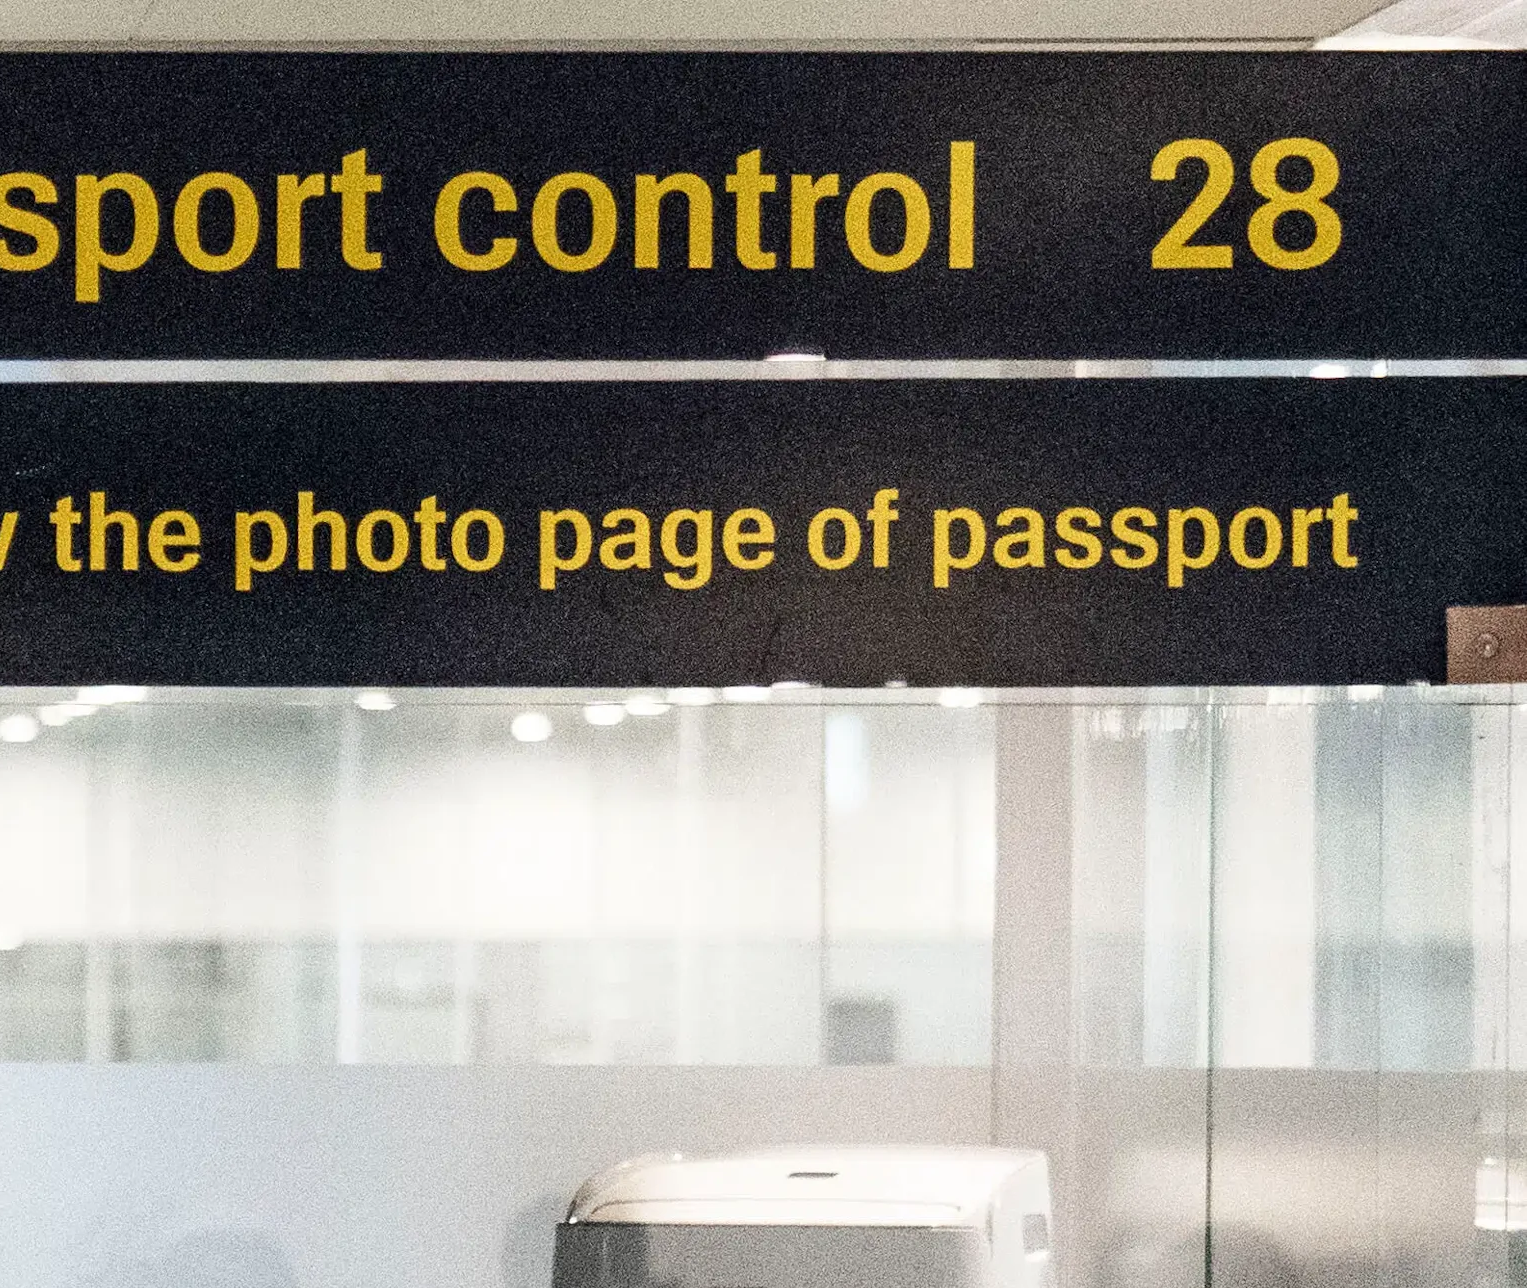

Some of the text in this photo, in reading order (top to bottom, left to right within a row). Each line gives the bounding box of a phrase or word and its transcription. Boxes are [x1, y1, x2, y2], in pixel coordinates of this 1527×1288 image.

[435, 141, 975, 272] control
[1151, 137, 1342, 270] 28
[50, 492, 200, 572] the
[236, 491, 505, 591] photo
[540, 507, 776, 590] page
[807, 488, 899, 571] of
[933, 493, 1358, 589] passport
